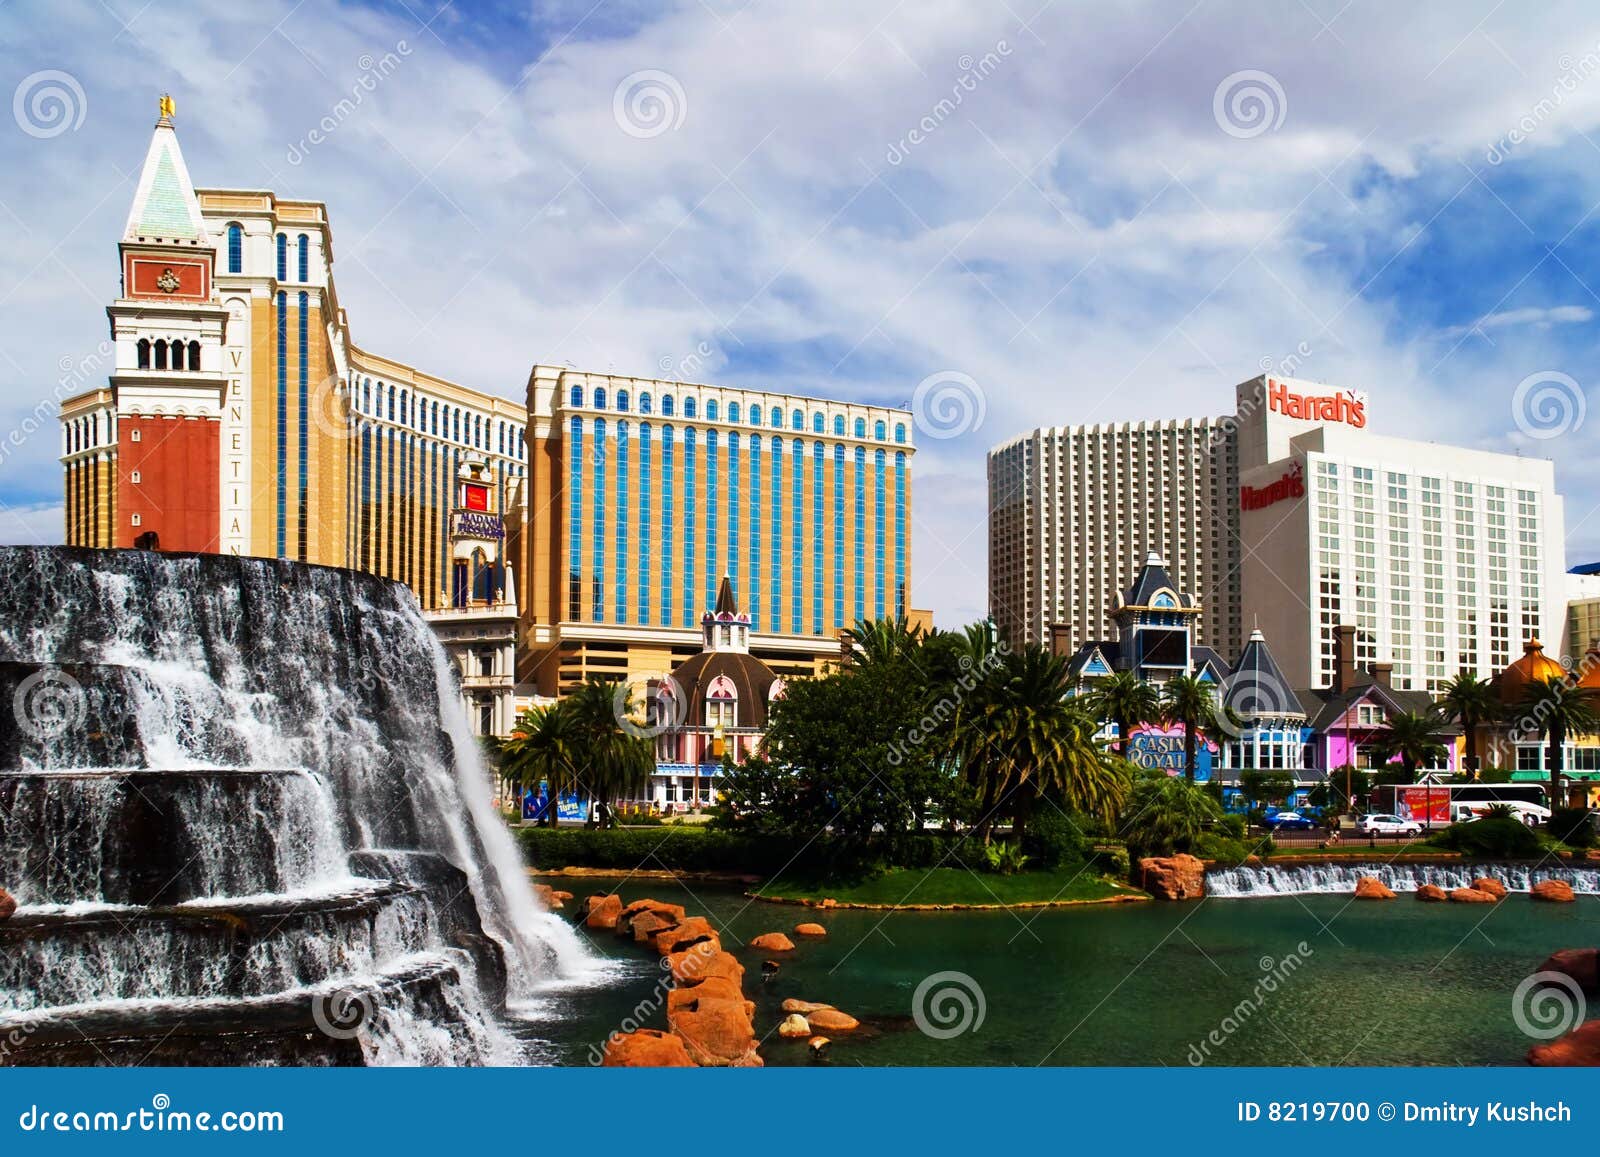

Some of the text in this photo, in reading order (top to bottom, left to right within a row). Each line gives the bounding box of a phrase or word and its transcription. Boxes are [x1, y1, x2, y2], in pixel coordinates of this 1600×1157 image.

[1269, 379, 1367, 429] Harrah's
[230, 350, 242, 556] VENETIAN
[1240, 468, 1305, 512] Harrah's
[1129, 748, 1198, 770] ROYAL
[1134, 736, 1198, 754] CASIN
